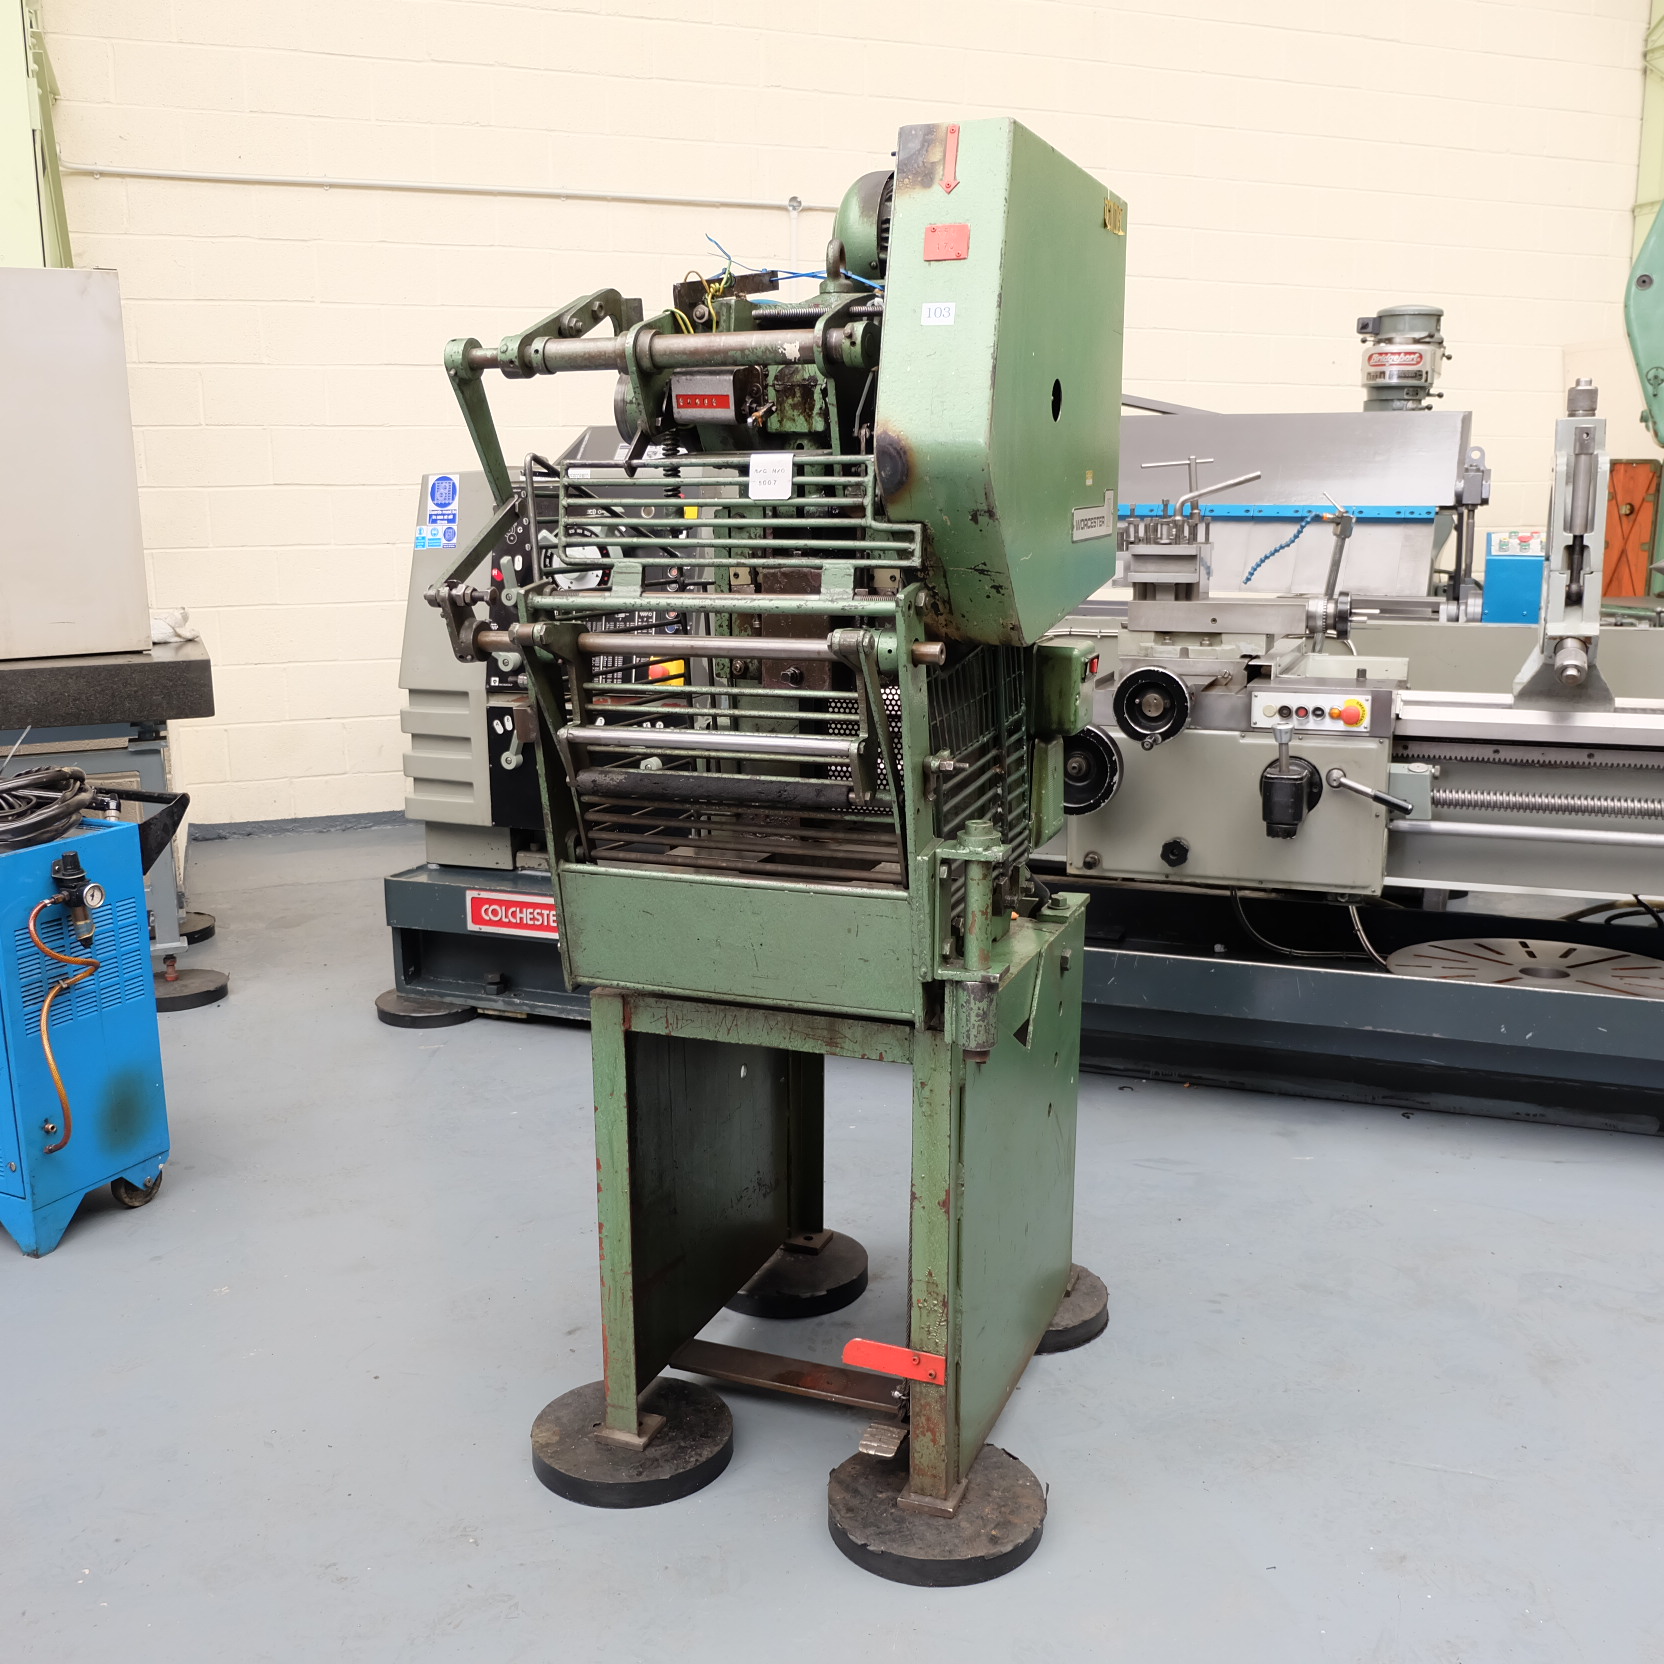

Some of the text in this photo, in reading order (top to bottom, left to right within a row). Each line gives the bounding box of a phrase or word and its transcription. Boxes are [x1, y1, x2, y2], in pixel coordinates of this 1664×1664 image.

[927, 306, 951, 319] 103
[1370, 353, 1420, 367] Bridgeport
[1075, 516, 1105, 531] WORCESTER
[481, 904, 558, 927] COLCHESTE
